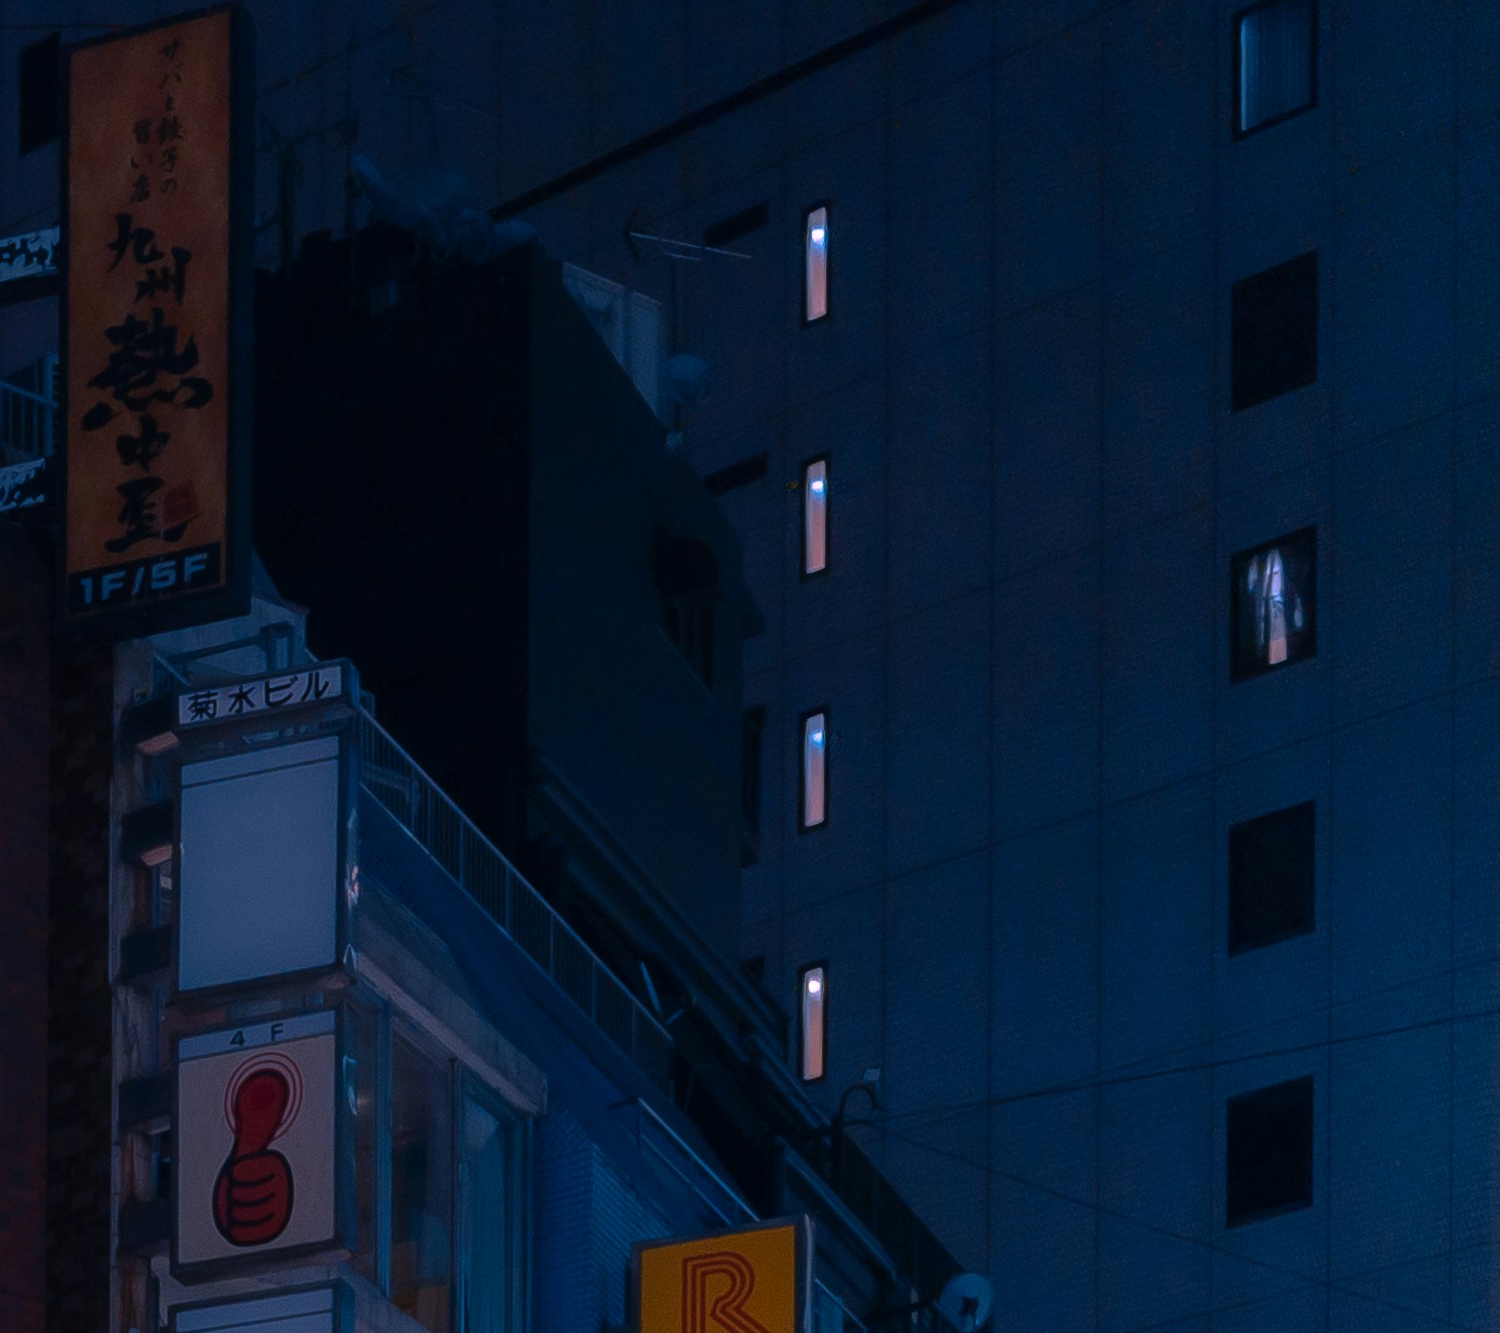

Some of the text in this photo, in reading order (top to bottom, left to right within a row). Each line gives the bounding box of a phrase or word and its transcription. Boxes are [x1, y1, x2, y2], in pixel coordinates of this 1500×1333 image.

[79, 553, 209, 605] 1F/5F
[187, 672, 330, 721] 菊水ビル
